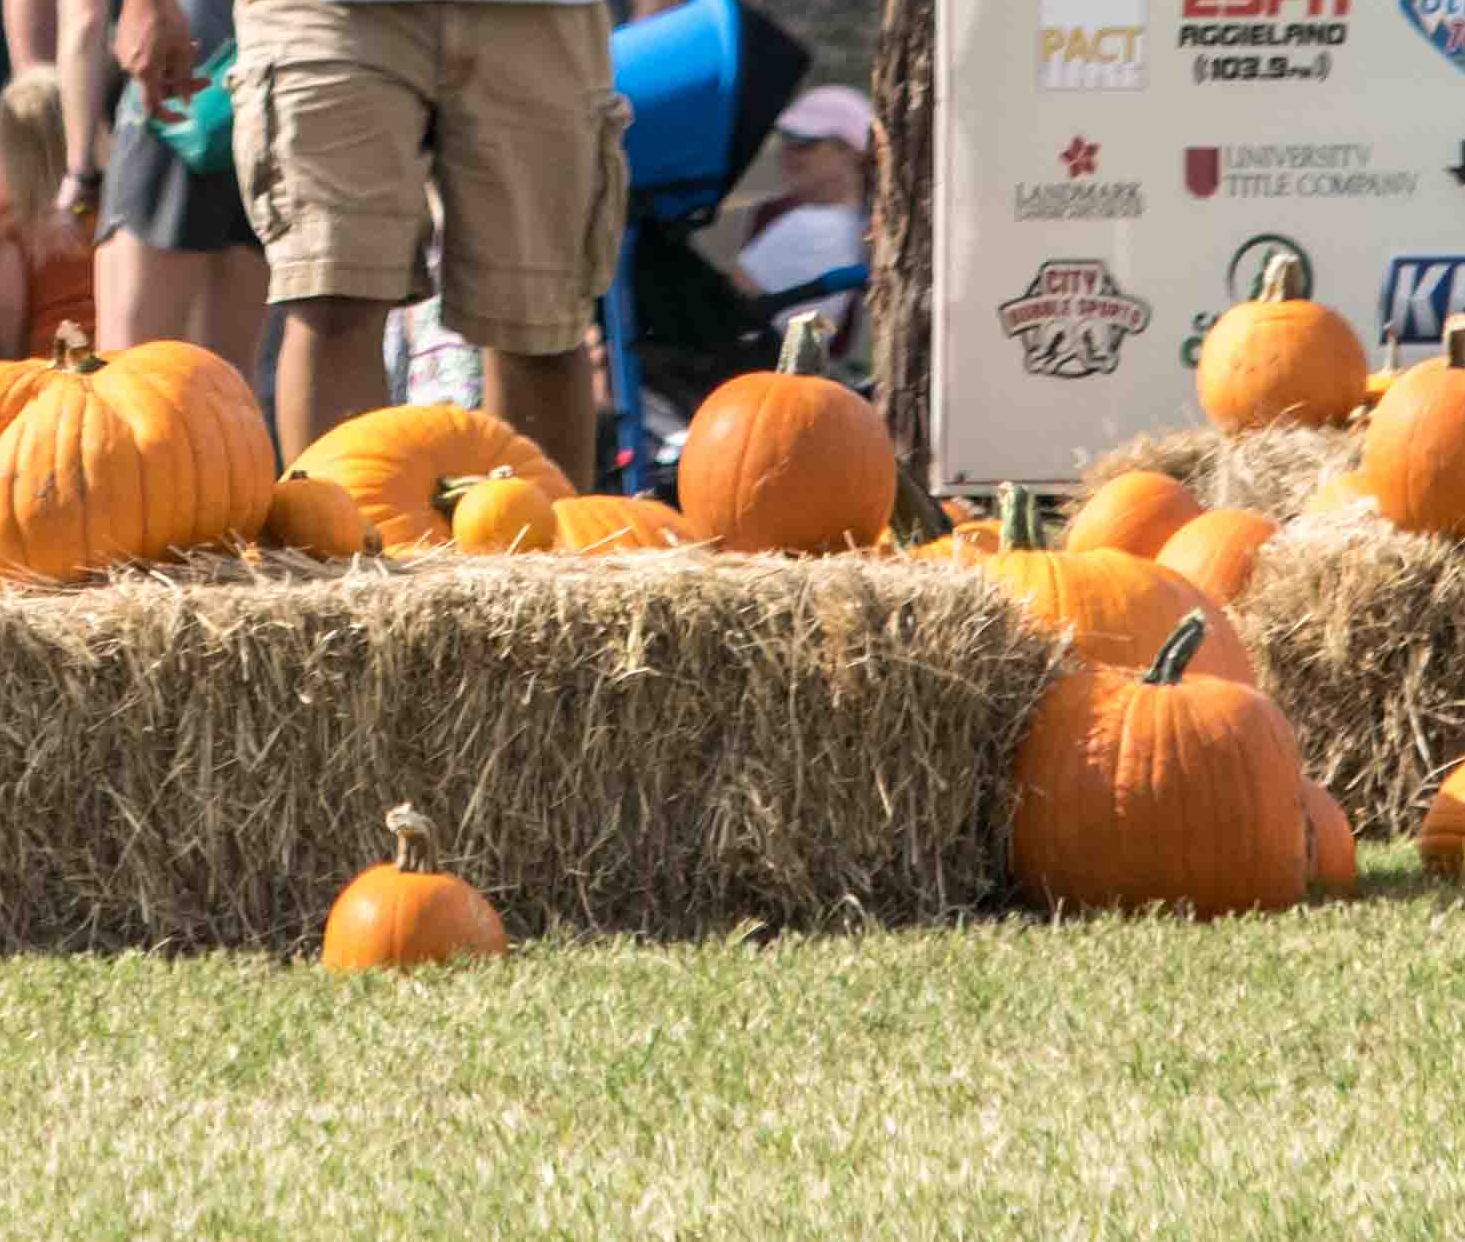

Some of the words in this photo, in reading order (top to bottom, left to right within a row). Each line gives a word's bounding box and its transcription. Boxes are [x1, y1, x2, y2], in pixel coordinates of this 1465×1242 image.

[1038, 25, 1144, 64] PACT
[1178, 22, 1348, 48] AGGIELAND
[1225, 144, 1373, 167] UNIVERSITY
[1224, 172, 1293, 197] TITLE
[1296, 171, 1418, 197] COMPANY
[1045, 269, 1099, 292] CITY
